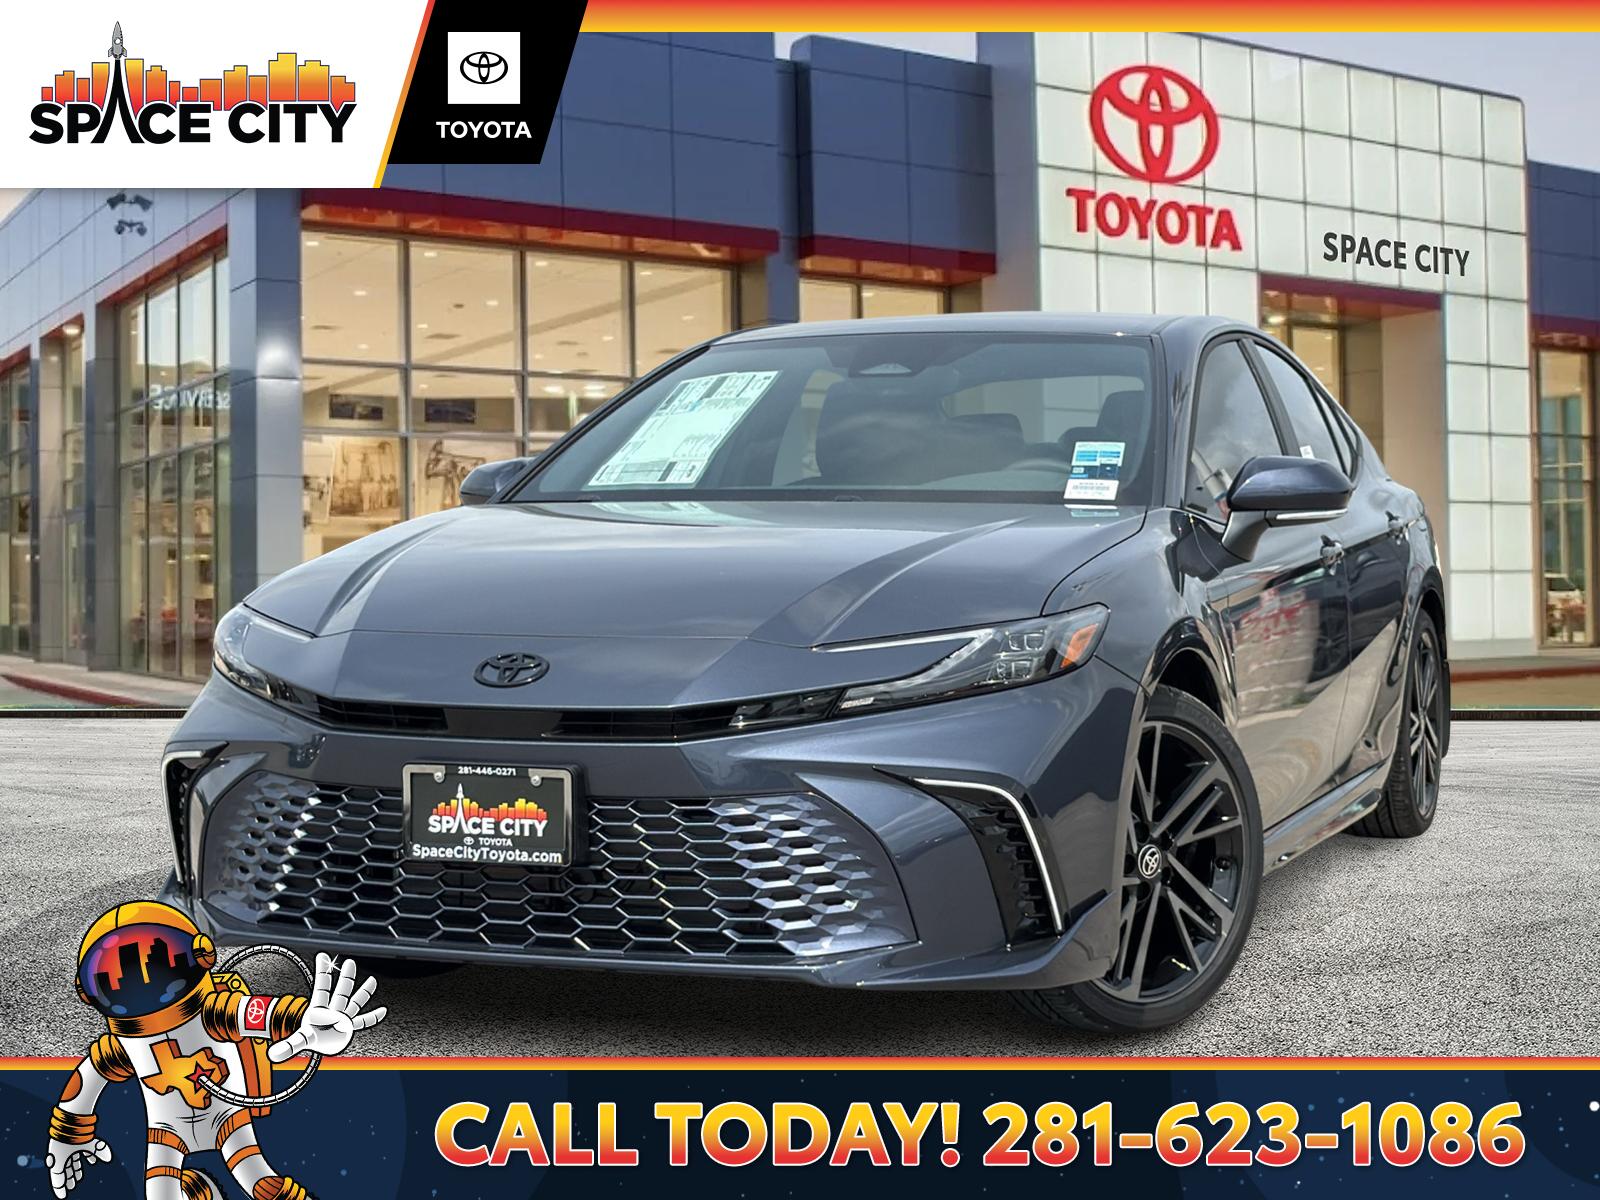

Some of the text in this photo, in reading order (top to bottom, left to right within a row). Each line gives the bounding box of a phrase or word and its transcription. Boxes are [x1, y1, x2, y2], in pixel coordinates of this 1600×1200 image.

[1066, 187, 1242, 251] TOYOTA
[1323, 232, 1470, 277] SPACE CITY
[458, 766, 516, 776] 281-446-0271
[428, 814, 548, 837] SPACE CITY
[478, 837, 513, 846] TOYOTA
[412, 843, 563, 864] SpaceCityToyota.com
